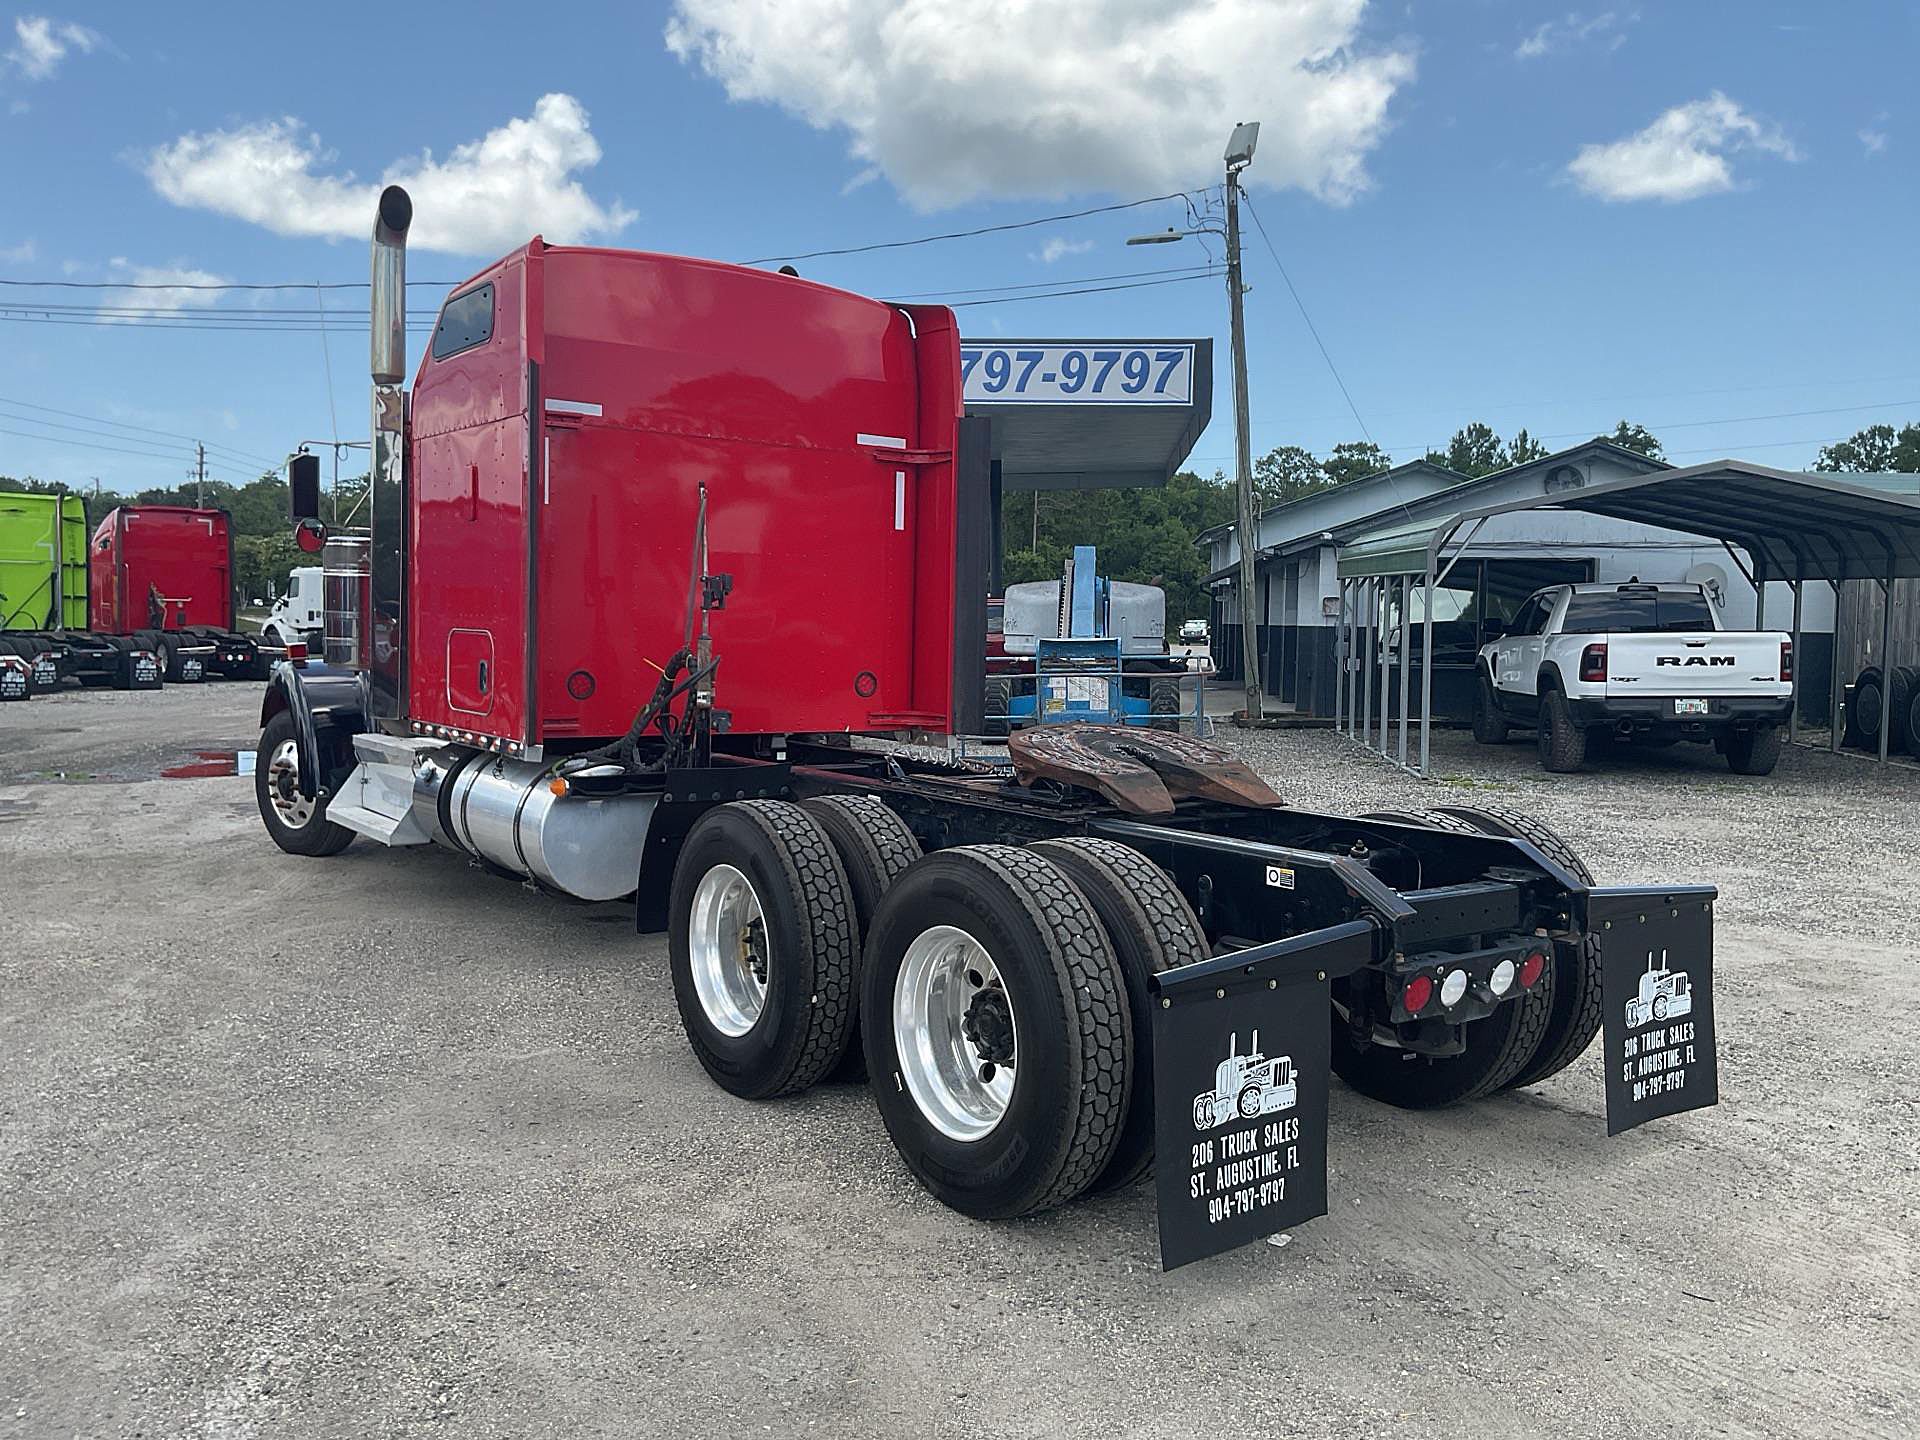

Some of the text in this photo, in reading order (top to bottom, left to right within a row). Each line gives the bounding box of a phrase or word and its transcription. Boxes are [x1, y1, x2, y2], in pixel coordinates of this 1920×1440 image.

[961, 351, 1184, 394] 797-9797
[1656, 656, 1735, 666] RAM
[1625, 1022, 1694, 1058] 206 TRUCK SALES
[1623, 1044, 1697, 1082] ST. AUGUSTINE, FL
[1633, 1069, 1685, 1102] 904-797-9797
[1192, 1117, 1299, 1168] 206 TRUCK SALES
[1190, 1145, 1300, 1199] ST. AUGUSTINE, FL
[1209, 1178, 1285, 1224] 904-797-9797
